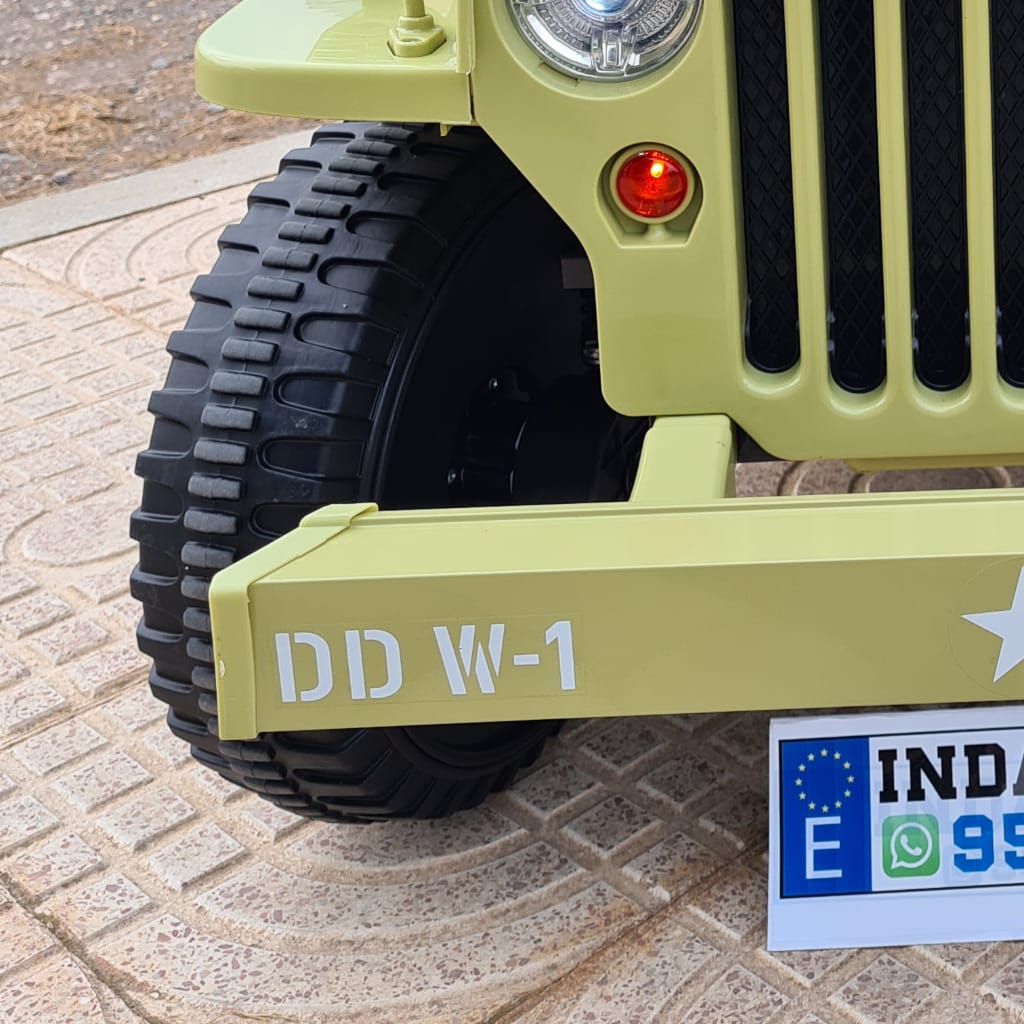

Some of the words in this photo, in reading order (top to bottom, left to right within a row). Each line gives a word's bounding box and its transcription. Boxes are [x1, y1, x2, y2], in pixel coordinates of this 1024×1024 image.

[274, 629, 403, 703] DD
[433, 620, 576, 695] W-1
[804, 815, 843, 880] E
